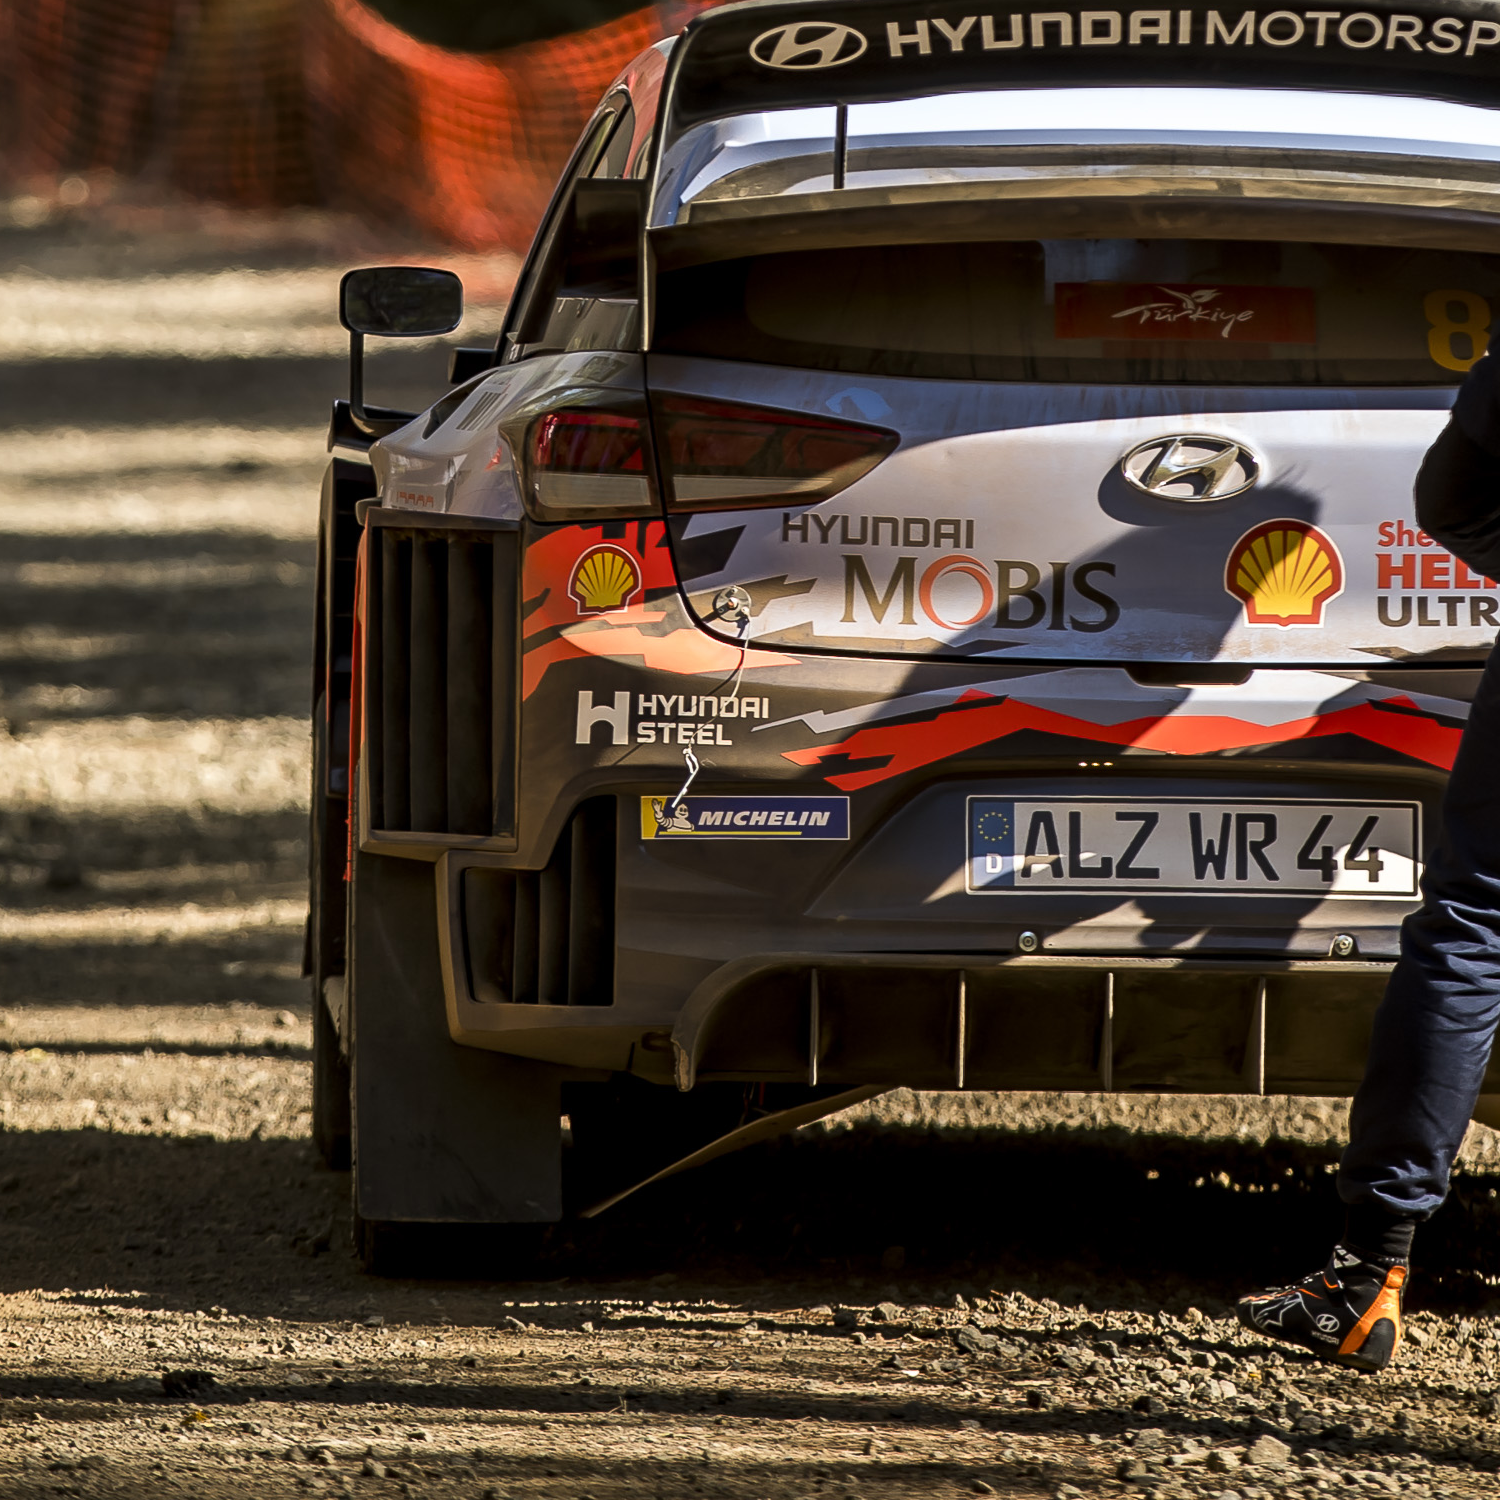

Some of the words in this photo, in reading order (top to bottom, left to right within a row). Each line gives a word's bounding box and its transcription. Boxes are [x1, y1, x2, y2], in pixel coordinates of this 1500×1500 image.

[888, 9, 1190, 57] HYUNDAI
[1424, 289, 1492, 372] 8
[782, 512, 975, 550] HYUNDAI
[1377, 519, 1442, 548] She
[840, 553, 1121, 633] MOBIS
[638, 694, 770, 719] HYUNDAI
[636, 721, 733, 747] STEEL
[698, 810, 831, 827] MICHELIN
[1020, 810, 1161, 880] ALZ
[1188, 812, 1280, 882] WR
[1296, 814, 1385, 883] 44
[986, 853, 1003, 874] D
